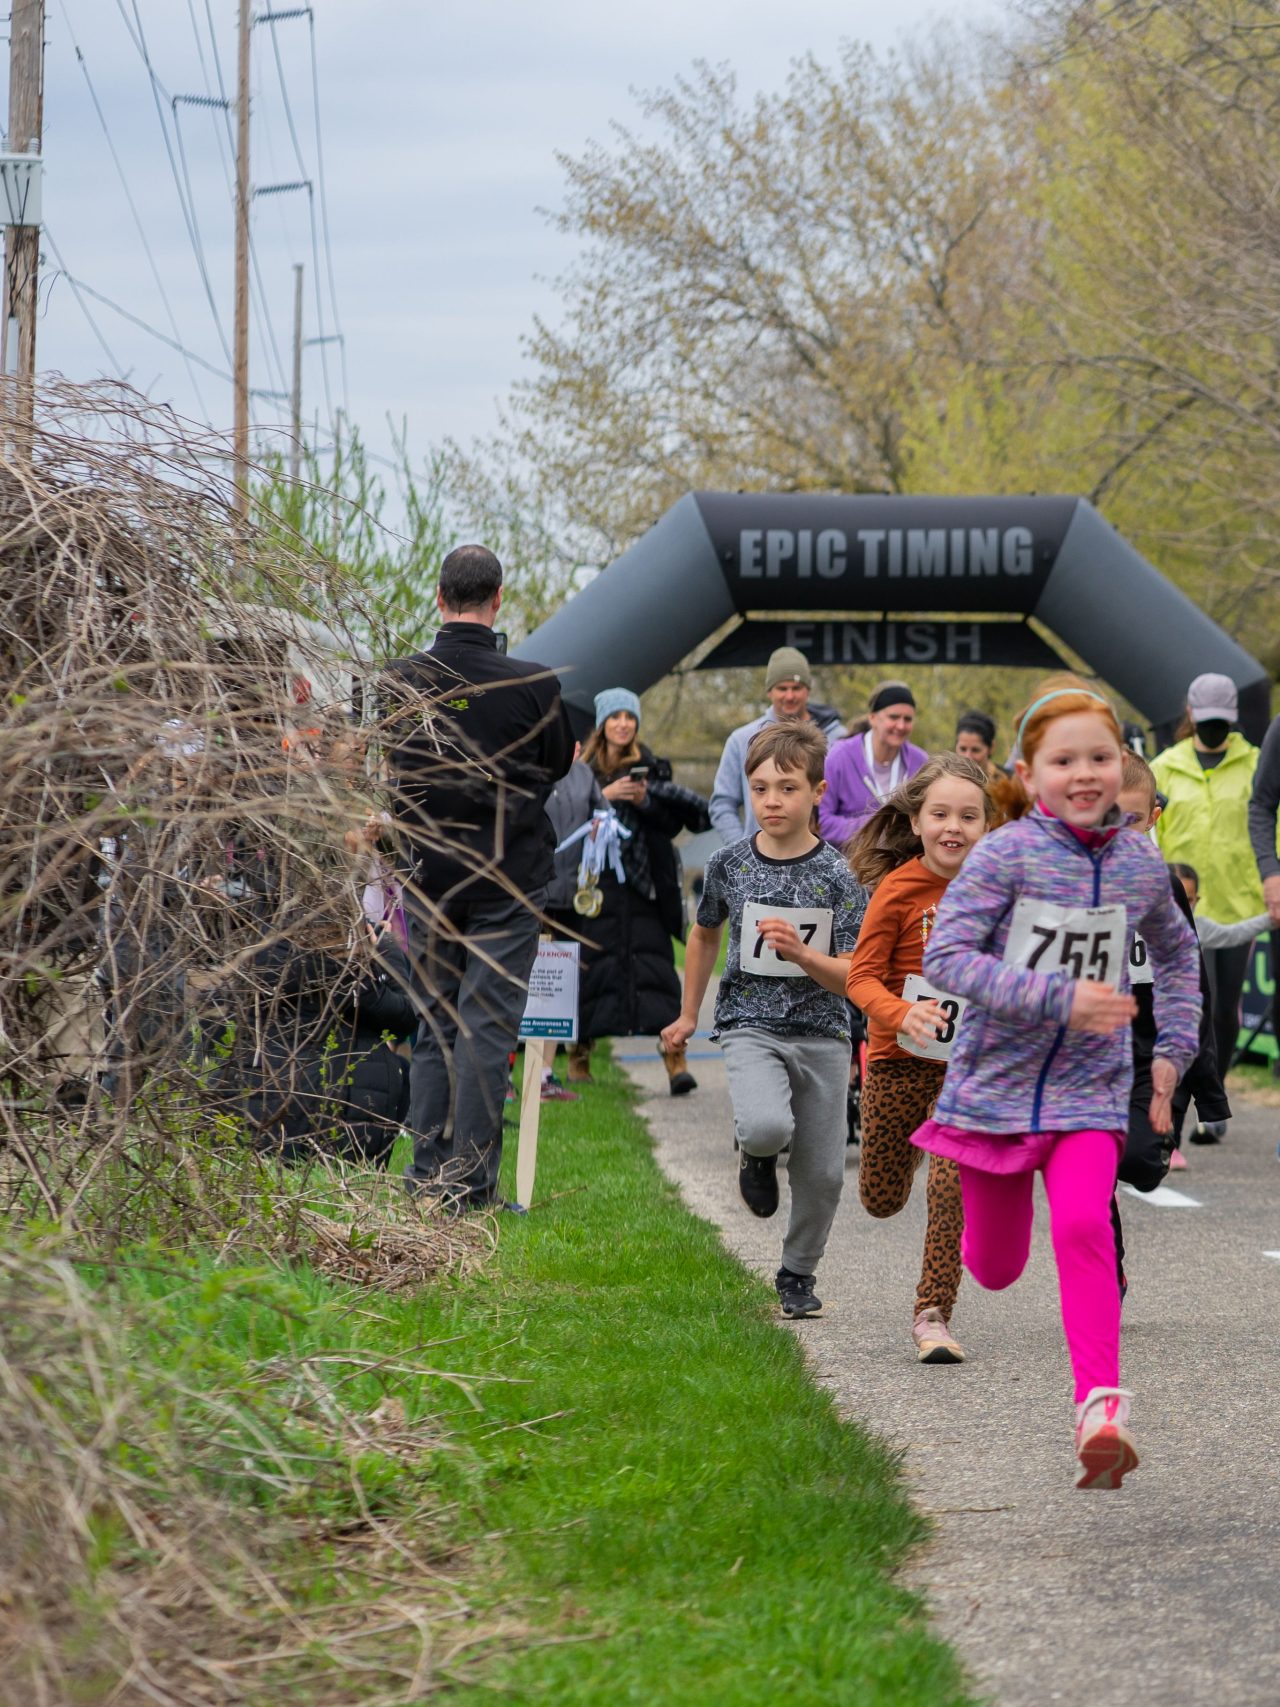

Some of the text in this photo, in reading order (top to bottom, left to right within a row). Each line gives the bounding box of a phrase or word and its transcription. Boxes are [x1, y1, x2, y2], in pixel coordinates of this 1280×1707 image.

[740, 526, 1034, 578] EPIC TIMING
[785, 623, 982, 663] FINISH
[753, 920, 817, 961] 77
[1026, 924, 1112, 982] 755
